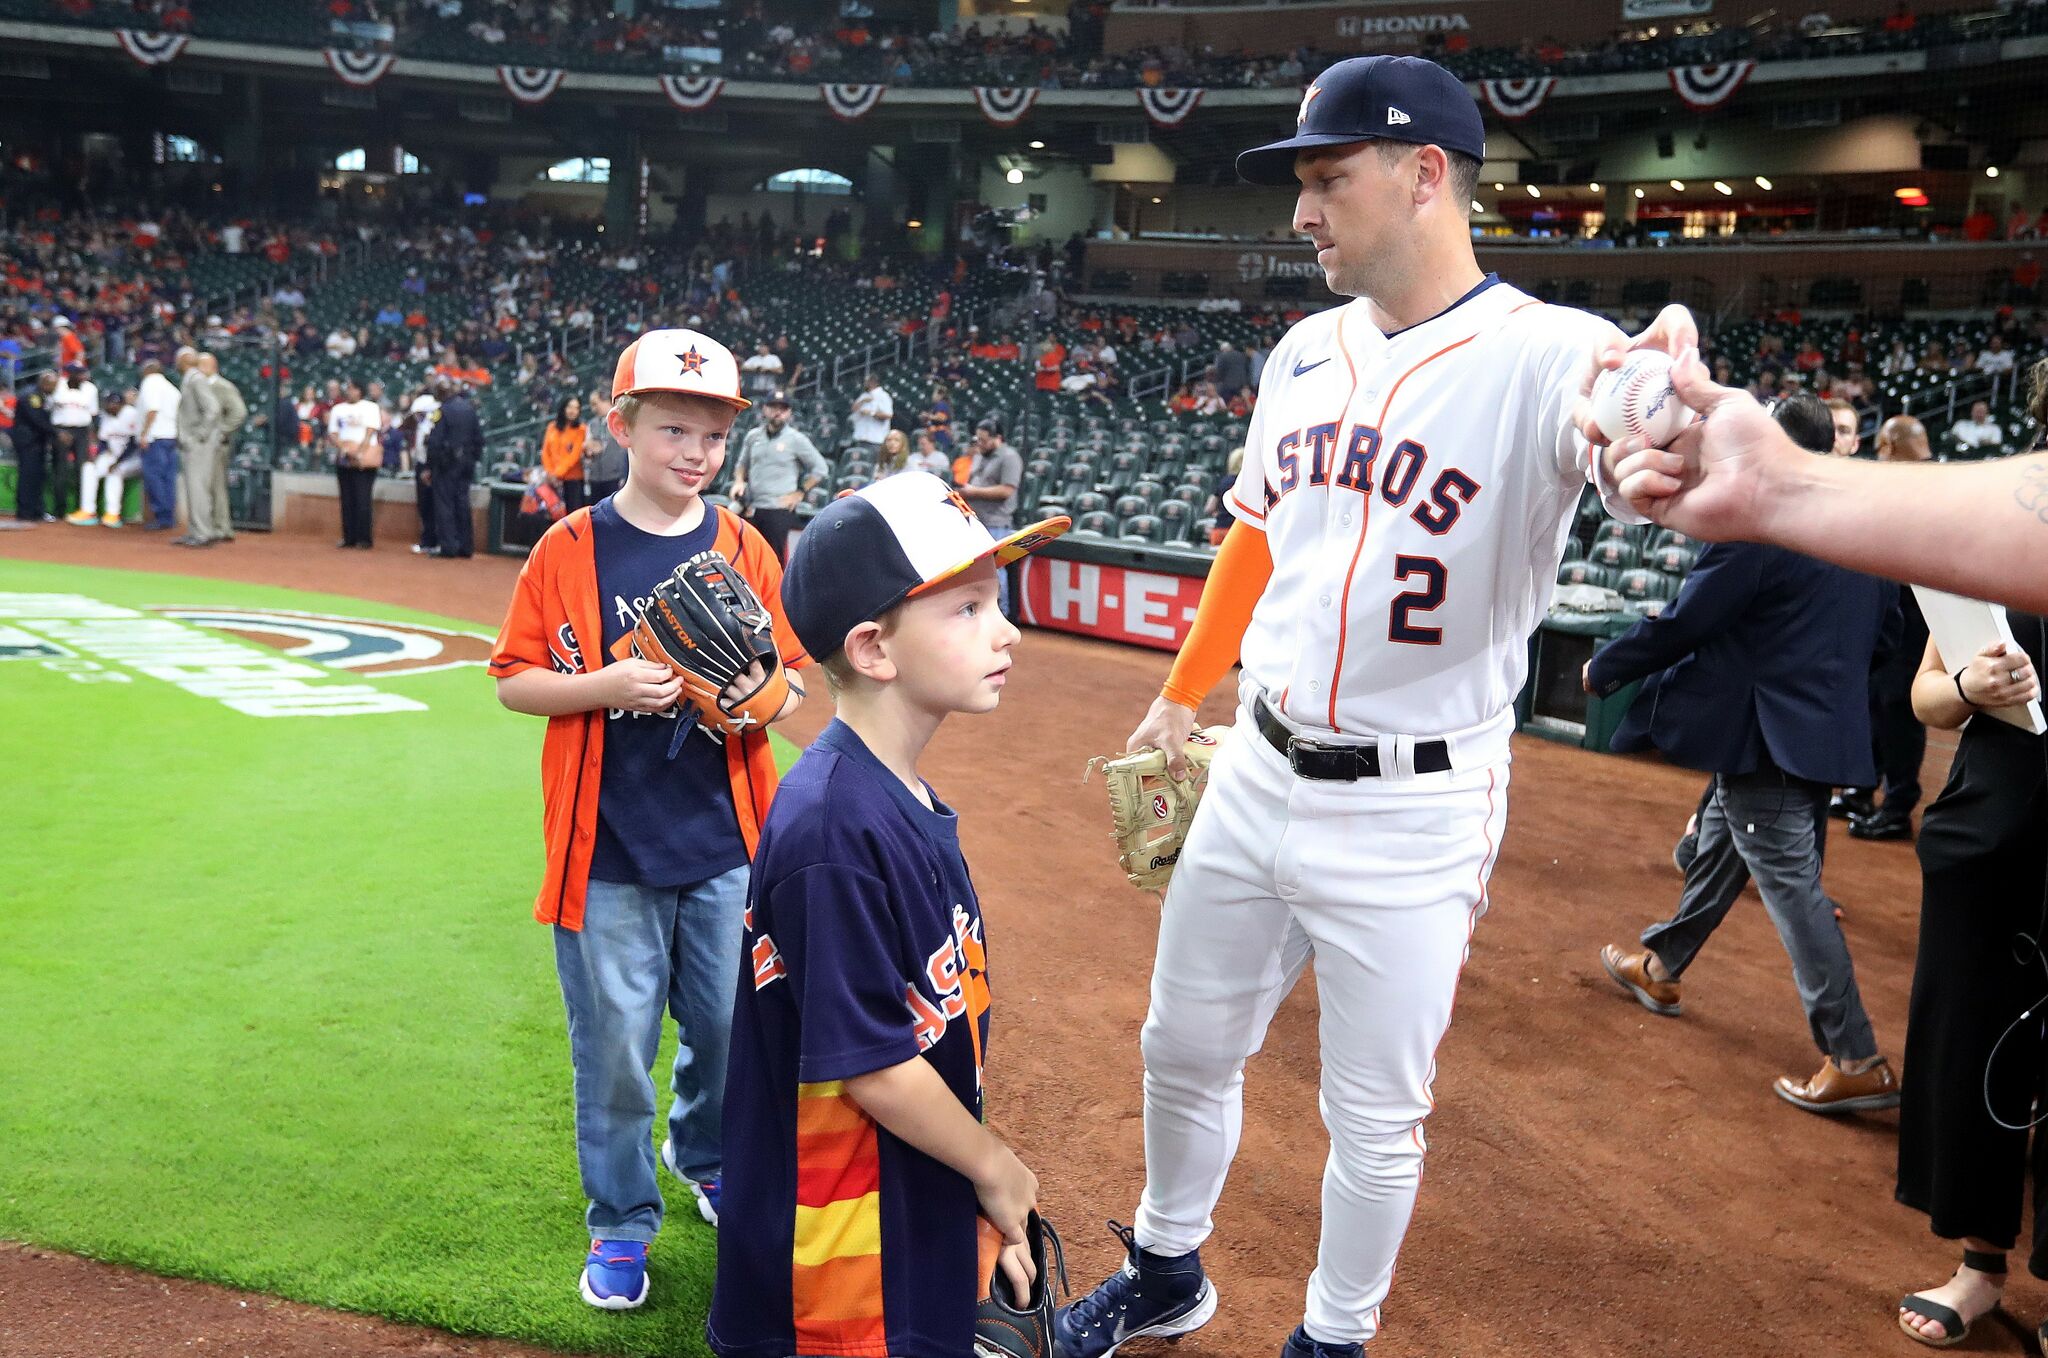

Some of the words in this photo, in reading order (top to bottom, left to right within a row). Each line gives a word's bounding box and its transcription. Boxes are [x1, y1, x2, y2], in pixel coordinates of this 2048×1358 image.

[1362, 13, 1470, 34] HONDA
[657, 599, 698, 650] EASTON
[1388, 553, 1449, 646] 2
